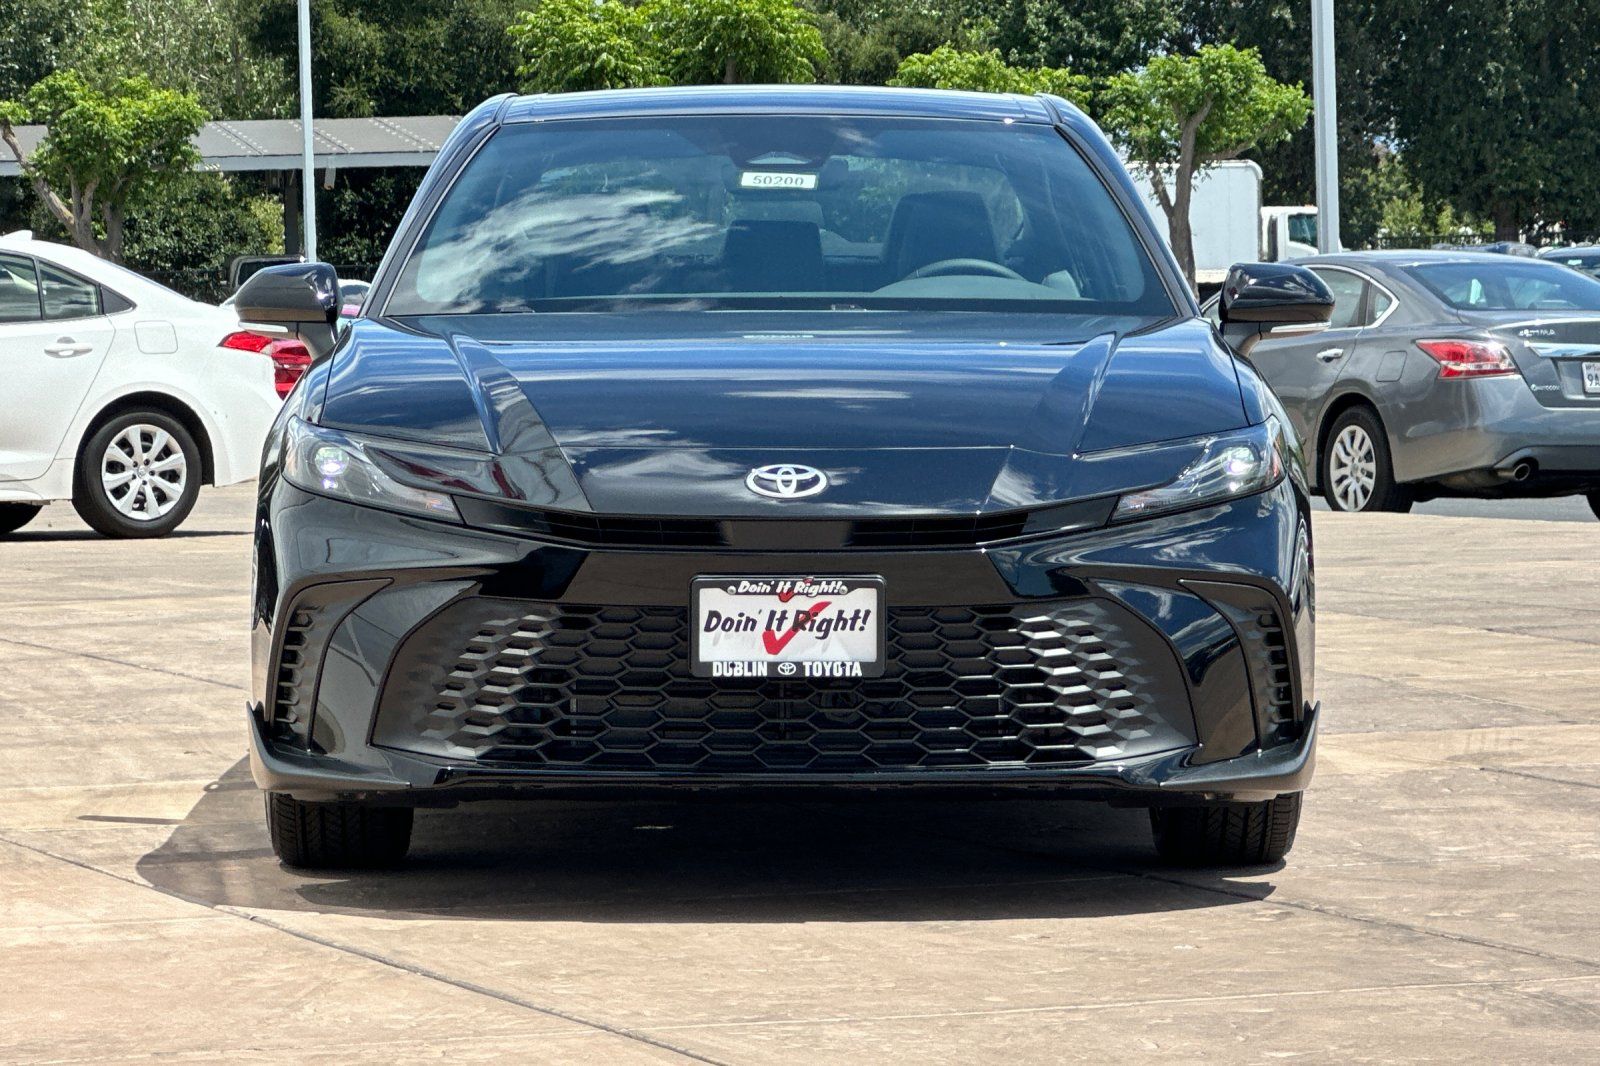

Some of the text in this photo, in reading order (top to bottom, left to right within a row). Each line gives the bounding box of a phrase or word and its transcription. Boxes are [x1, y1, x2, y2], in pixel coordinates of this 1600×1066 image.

[753, 175, 804, 185] 50200
[738, 579, 841, 597] Doin' It Right!
[704, 609, 871, 640] Doin' It Right!
[713, 662, 862, 676] DUBLIN TOYOTA
